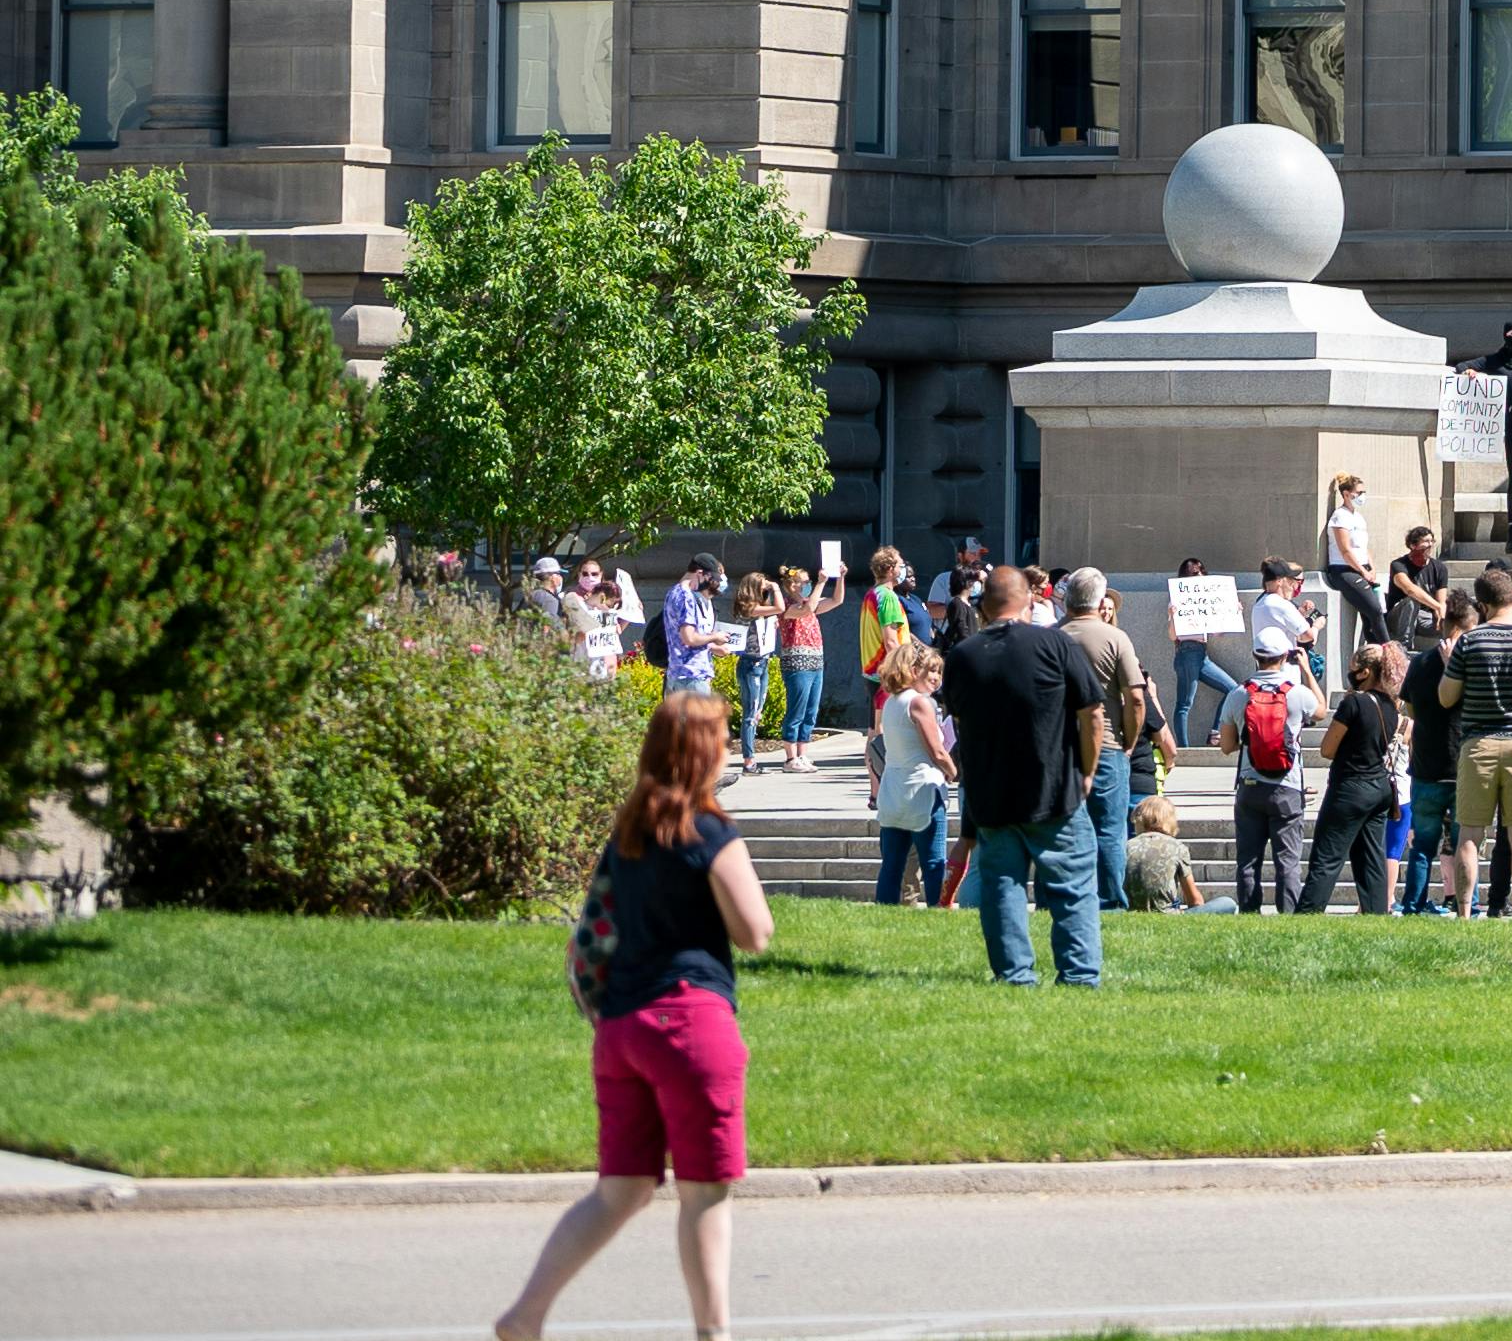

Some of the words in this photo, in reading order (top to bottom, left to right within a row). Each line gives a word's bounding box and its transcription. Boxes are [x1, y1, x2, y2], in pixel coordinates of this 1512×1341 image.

[1443, 376, 1504, 399] FUND
[1441, 399, 1503, 418] COMMUNITY
[1441, 418, 1500, 435] DE-FUND
[1440, 436, 1498, 455] POLICE
